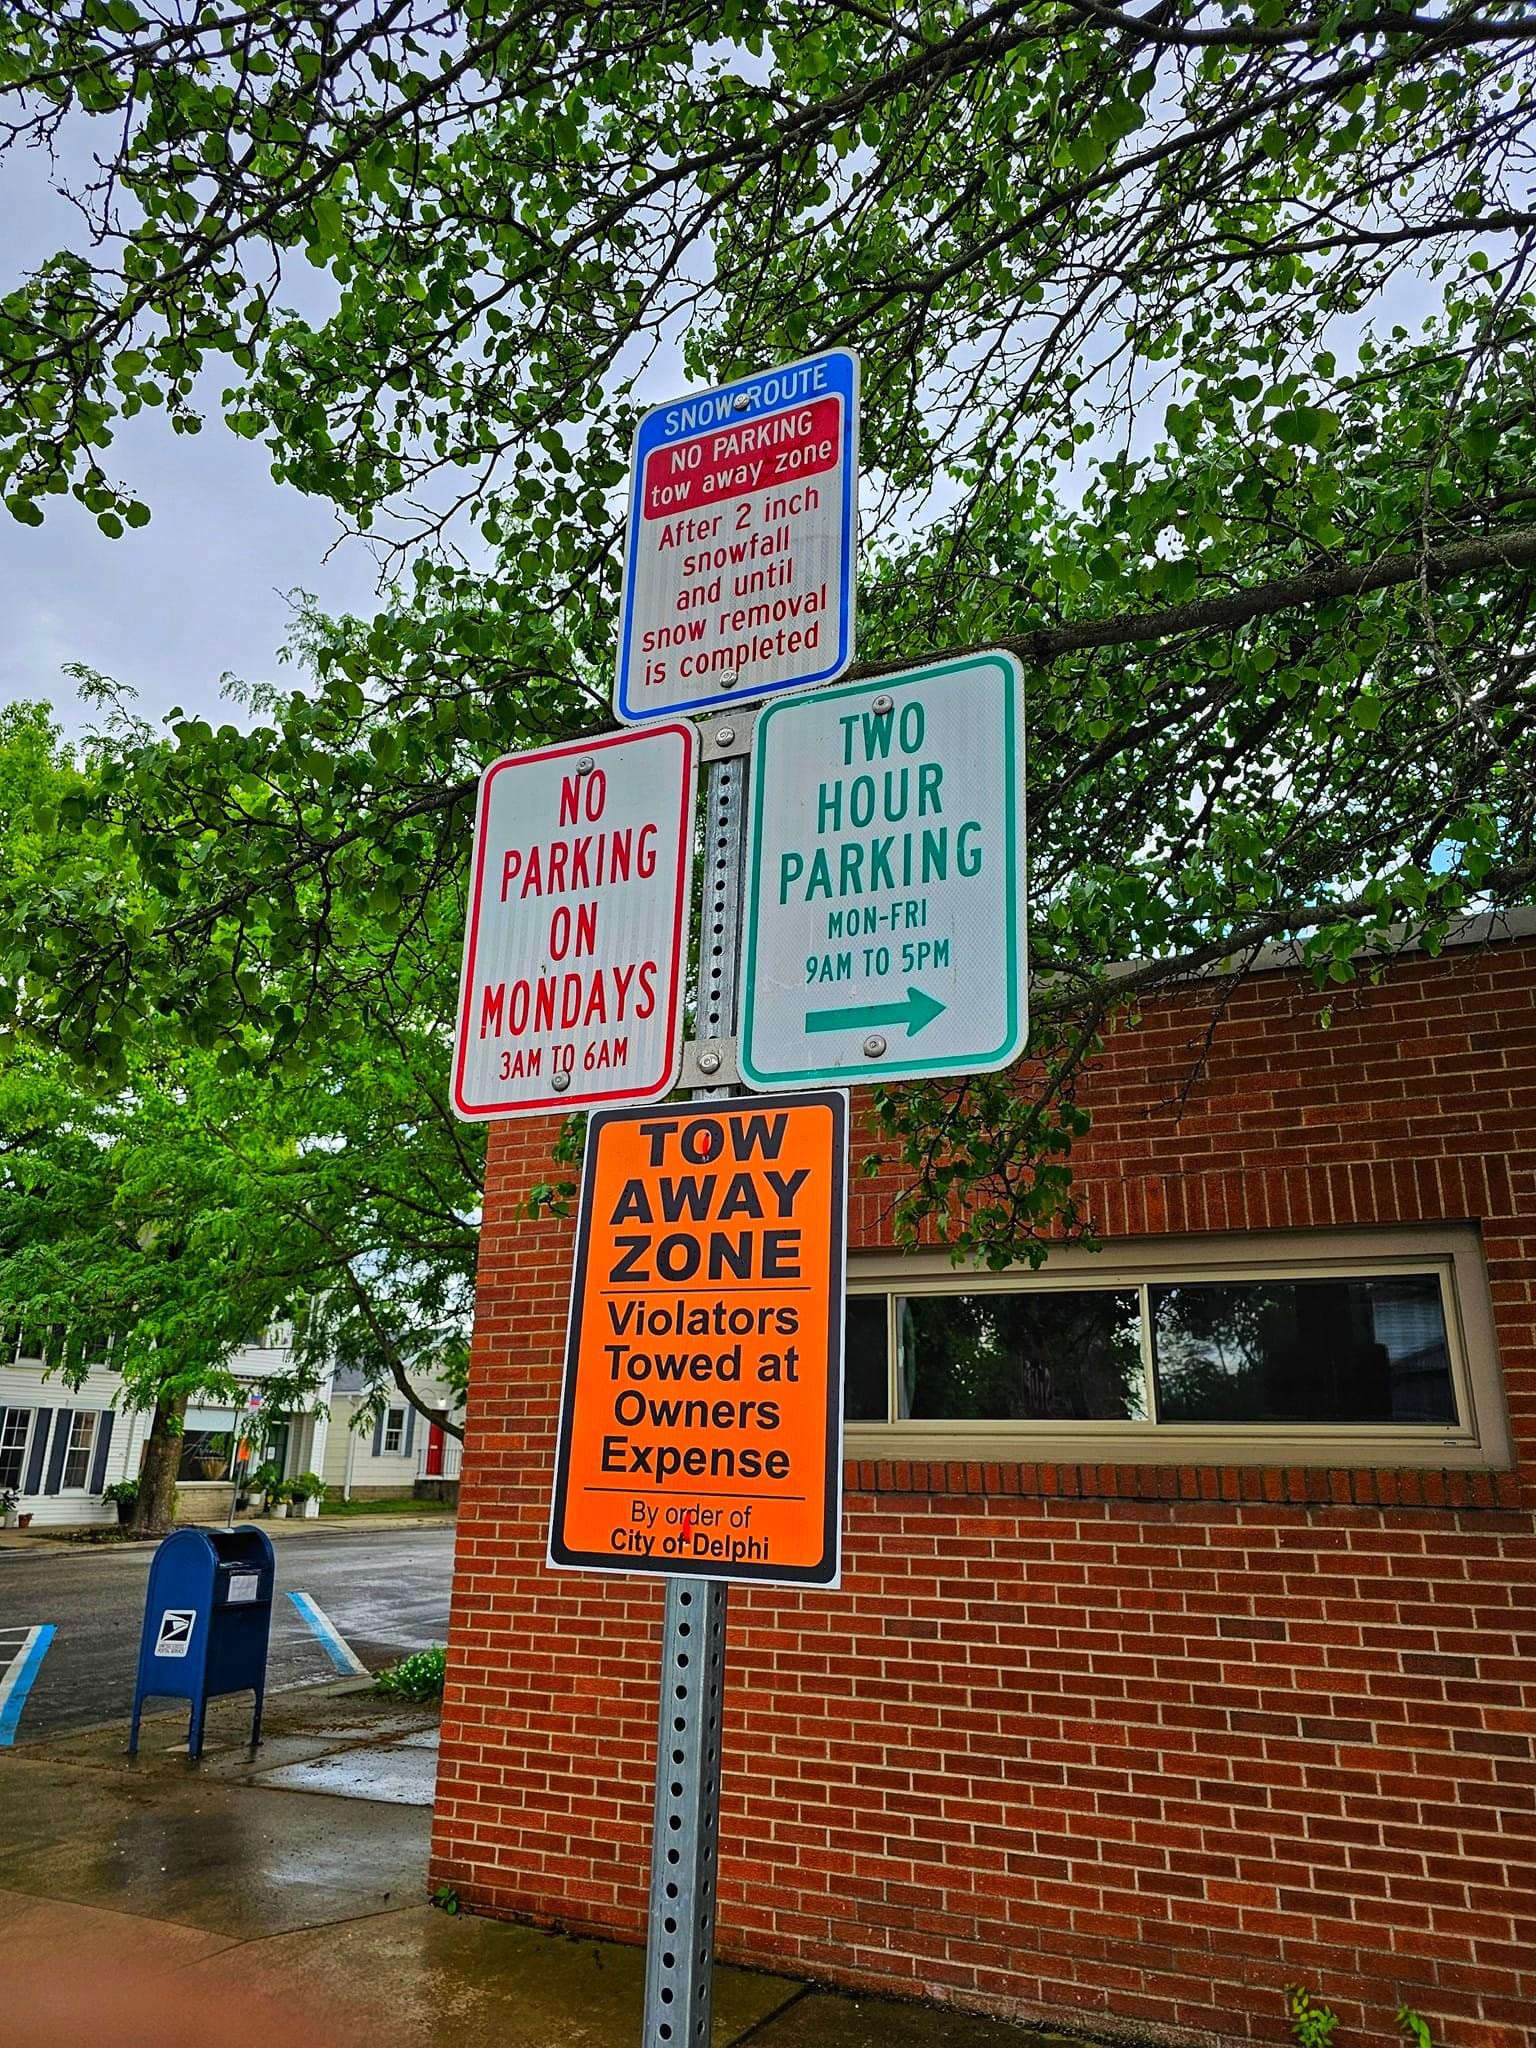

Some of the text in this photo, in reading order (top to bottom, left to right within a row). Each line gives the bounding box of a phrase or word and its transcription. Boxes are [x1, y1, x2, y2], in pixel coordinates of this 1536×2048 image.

[664, 363, 828, 436] SNOW ROUTE
[671, 411, 812, 474] NO PARKING
[651, 439, 832, 508] tow away zone
[658, 486, 819, 551] After 2 inch
[683, 525, 790, 577] snowfall
[676, 557, 792, 611] and until
[642, 583, 827, 652] snow removal
[645, 621, 820, 685] is completed
[839, 701, 925, 766] TWO
[559, 769, 606, 827] NO
[817, 763, 944, 834] HOUR
[500, 823, 658, 902] PARKING
[779, 821, 983, 905] PARKING
[549, 902, 598, 961] ON
[828, 899, 928, 940] MON-FRI
[806, 939, 950, 985] 9AM TO 5PM
[479, 961, 657, 1040] MONDAYS
[499, 1036, 628, 1081] 3AM TO 6AM
[640, 1113, 789, 1167] TOW
[609, 1169, 811, 1225] AWAY
[609, 1229, 801, 1282] ZONE
[608, 1300, 799, 1336] Violators
[604, 1344, 799, 1382] Towed at
[614, 1389, 780, 1430] Owners
[601, 1435, 790, 1483] Expense
[631, 1500, 752, 1528] By order of
[611, 1528, 769, 1562] City of Delphi
